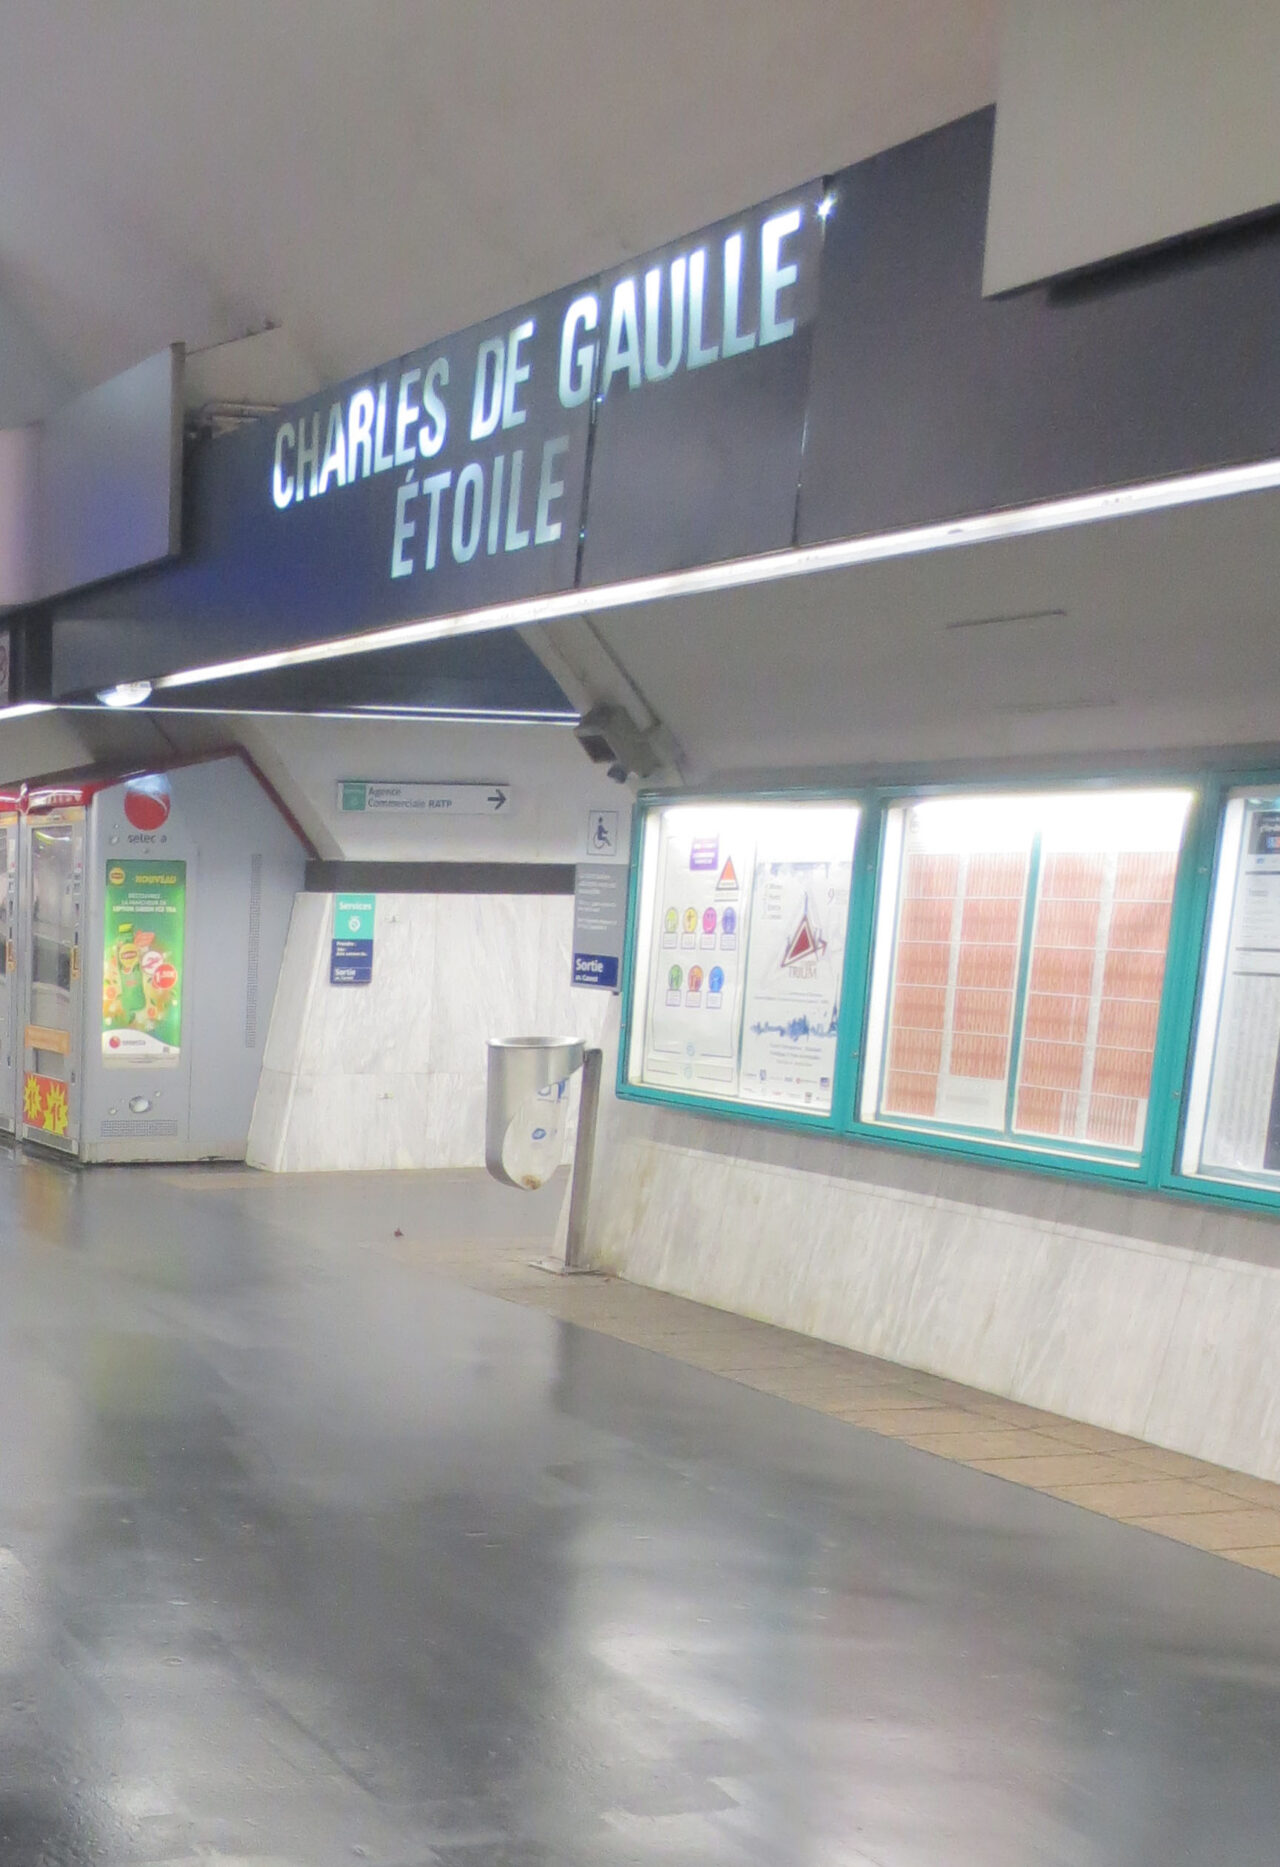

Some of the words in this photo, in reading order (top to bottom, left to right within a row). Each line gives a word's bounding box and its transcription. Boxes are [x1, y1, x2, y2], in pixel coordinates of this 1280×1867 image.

[272, 355, 450, 510] CHARLES
[470, 317, 537, 442] DE
[558, 208, 801, 409] GAULLE
[390, 434, 570, 579] ÉTOILE
[369, 787, 402, 797] Agence
[428, 800, 453, 809] RATP
[338, 902, 372, 911] Services
[575, 958, 603, 973] Sortie
